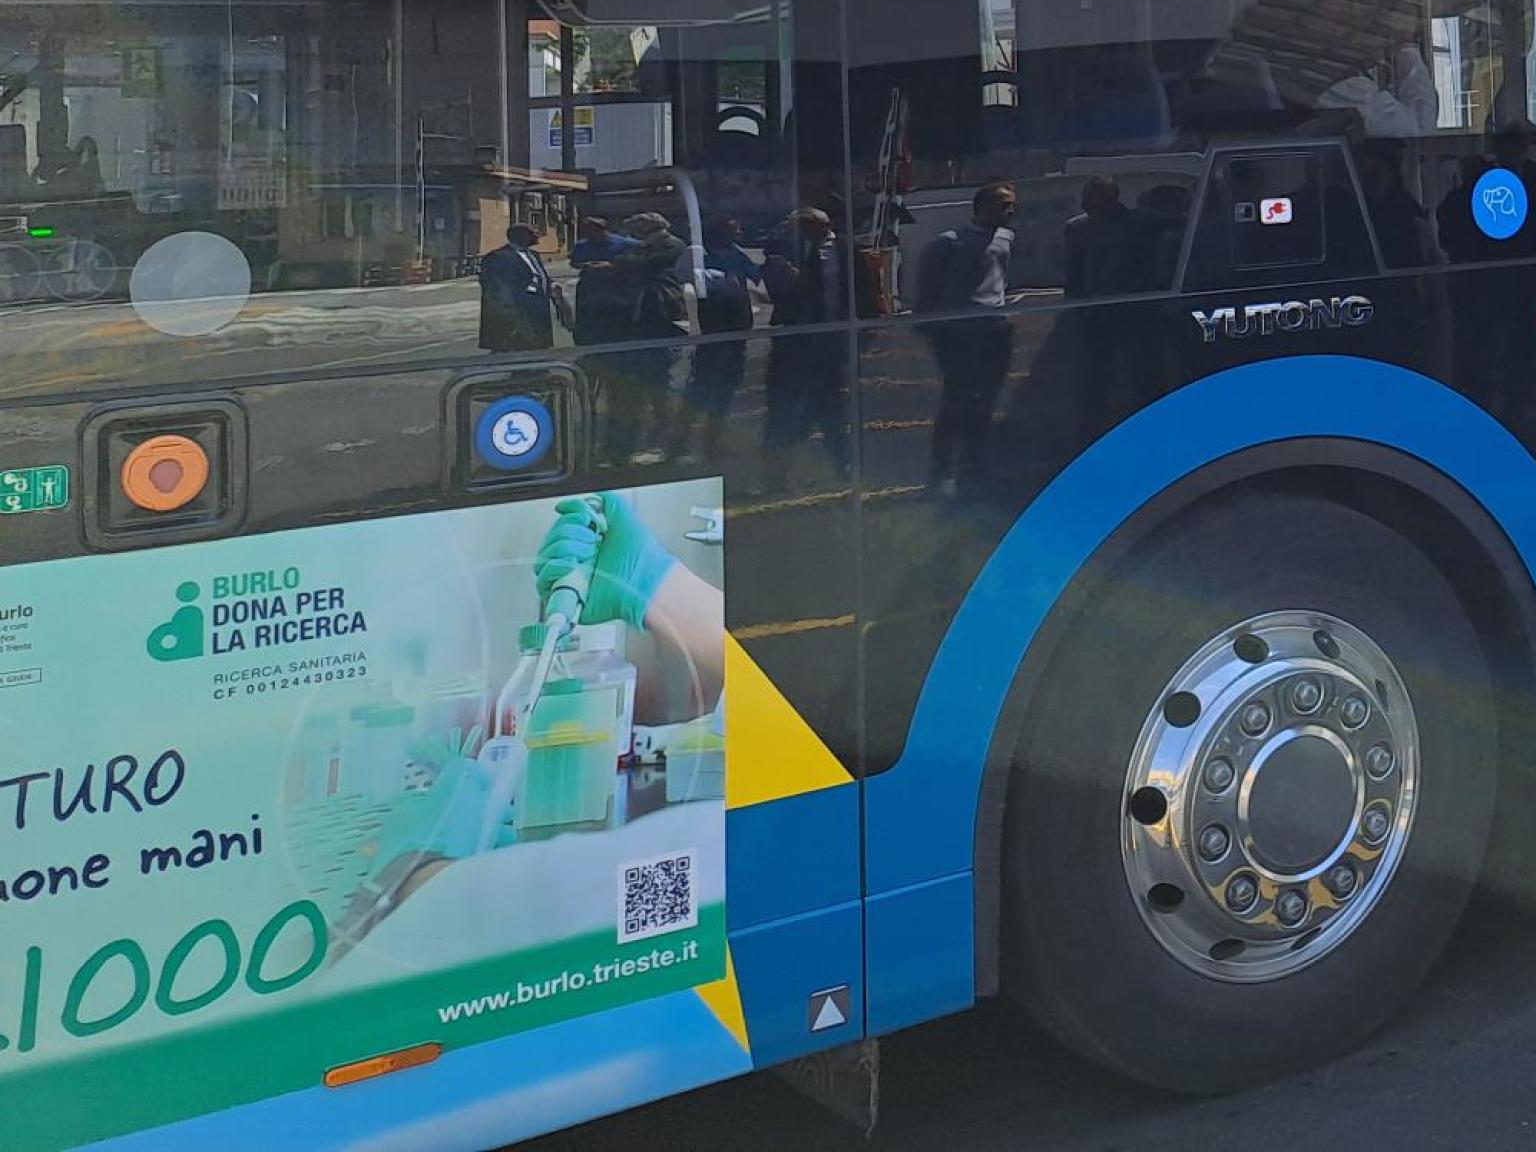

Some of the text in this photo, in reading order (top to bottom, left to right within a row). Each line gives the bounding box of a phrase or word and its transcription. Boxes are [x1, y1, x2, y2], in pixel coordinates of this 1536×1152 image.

[1191, 295, 1375, 342] YUTONG
[213, 567, 300, 599] BURLO
[212, 587, 345, 627] DONA PER
[212, 611, 368, 655] LA RICERCA
[213, 651, 367, 685] RICERCA SANITARIA
[246, 666, 368, 695] 00124430323
[0, 749, 185, 830] TURO
[140, 814, 263, 875] mani
[438, 939, 699, 1024] www.burlo.trieste.it
